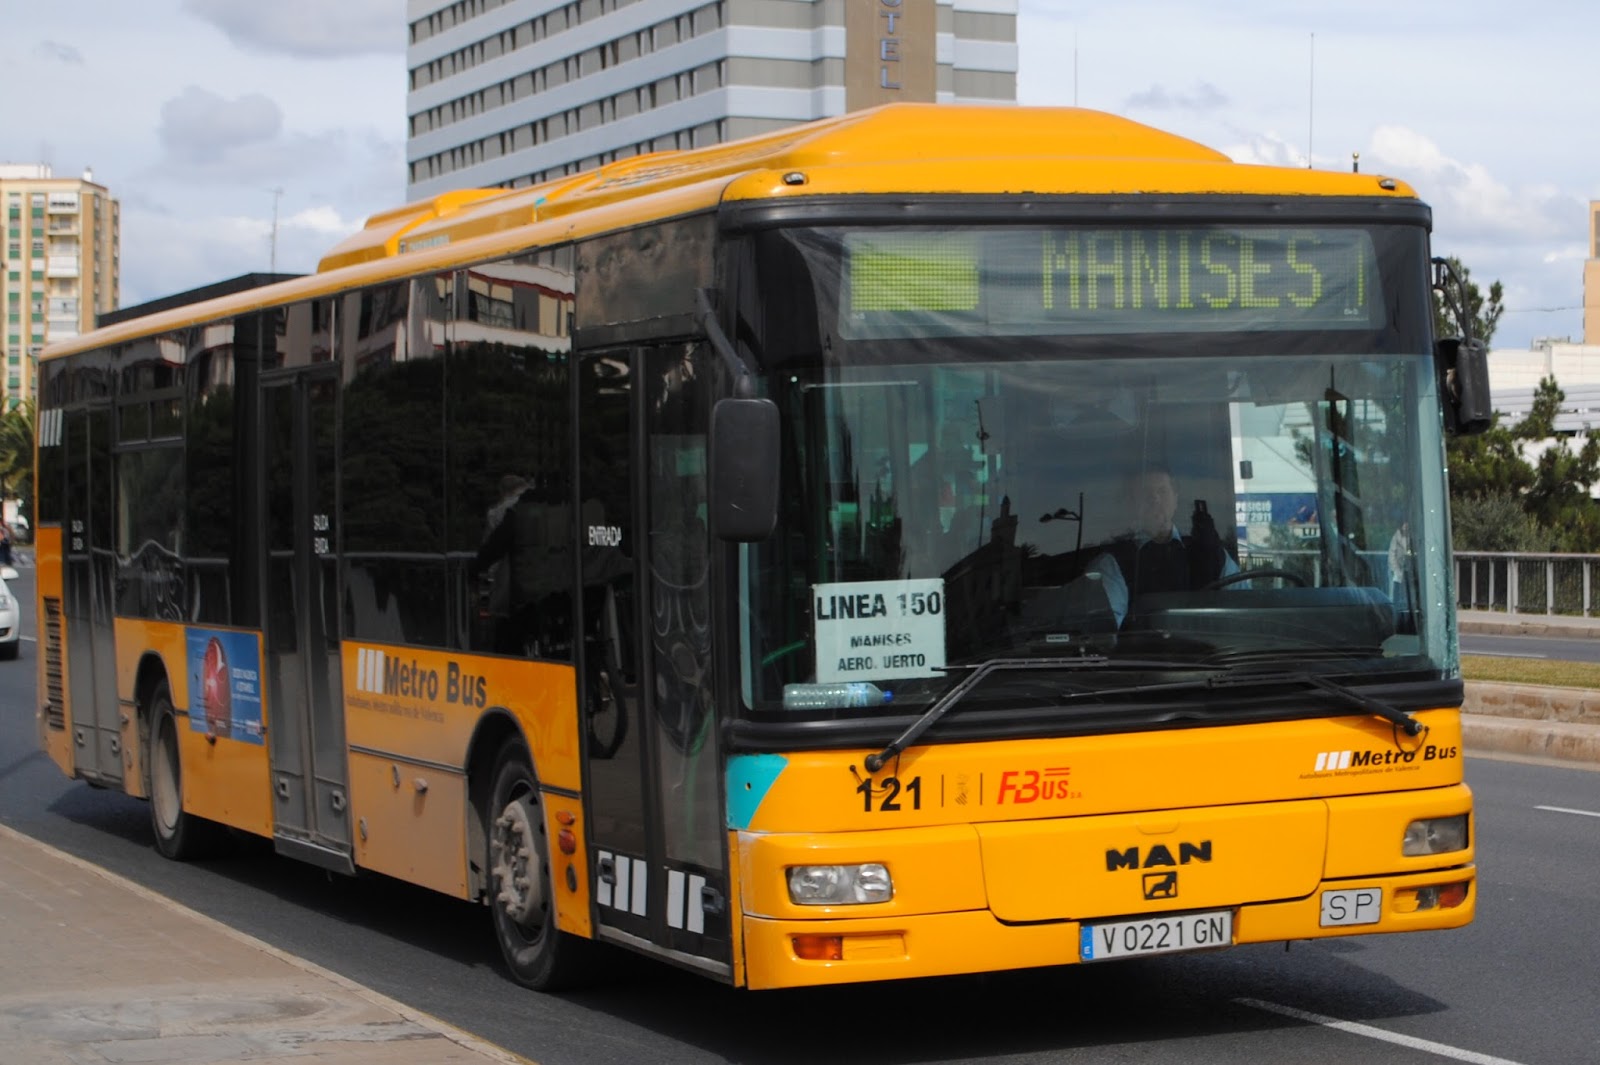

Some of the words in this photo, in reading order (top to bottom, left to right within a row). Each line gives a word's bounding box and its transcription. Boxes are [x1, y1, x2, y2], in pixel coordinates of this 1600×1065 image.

[1041, 230, 1322, 309] MANISES
[588, 525, 622, 547] ENTRADA
[816, 593, 888, 620] LINEA
[896, 591, 941, 616] 150
[850, 633, 912, 648] MANISES
[838, 653, 926, 671] AEROUERTO
[384, 656, 439, 701] Metro
[446, 661, 487, 708] Bus
[1351, 751, 1416, 767] Metro
[1423, 745, 1457, 761] Bus
[856, 776, 921, 812] 121
[1105, 840, 1212, 872] MAN
[1328, 893, 1373, 921] SP
[1102, 926, 1117, 953] V
[1123, 921, 1185, 951] 0221
[1193, 916, 1224, 945] GN
